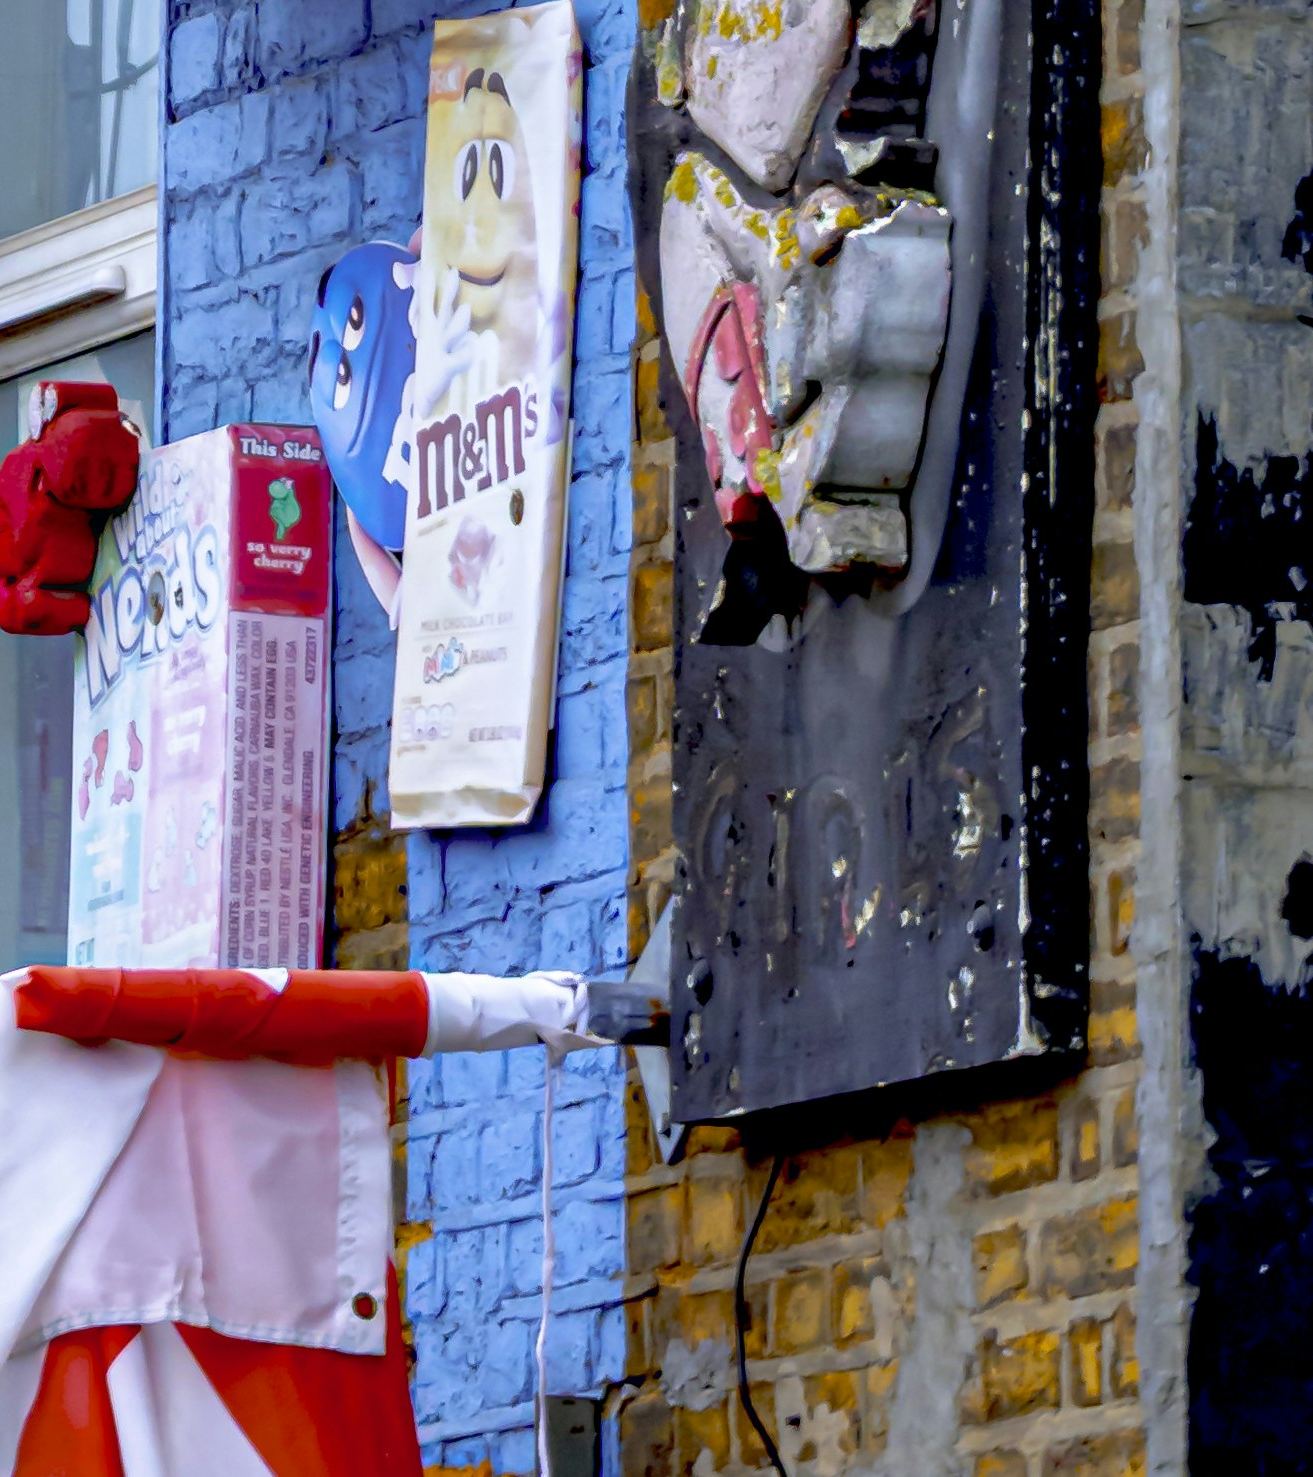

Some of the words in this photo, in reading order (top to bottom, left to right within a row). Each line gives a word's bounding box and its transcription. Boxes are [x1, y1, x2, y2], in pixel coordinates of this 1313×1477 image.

[239, 437, 277, 458] This
[282, 440, 322, 462] Side
[236, 620, 247, 650] THAN
[285, 641, 297, 663] USA
[236, 653, 247, 682] LESS
[235, 686, 246, 711] AND
[265, 667, 277, 719] CONTAIN
[284, 705, 296, 720] CA
[264, 723, 275, 748] MAY
[246, 815, 257, 865] NATURAL
[260, 850, 271, 865] 40
[300, 834, 312, 884] GENETIC
[279, 894, 291, 908] BY
[299, 888, 310, 918] WITH
[228, 899, 240, 968] GREDIENTS:
[278, 910, 290, 967] TRIBUTED
[297, 922, 309, 969] ODUCED
